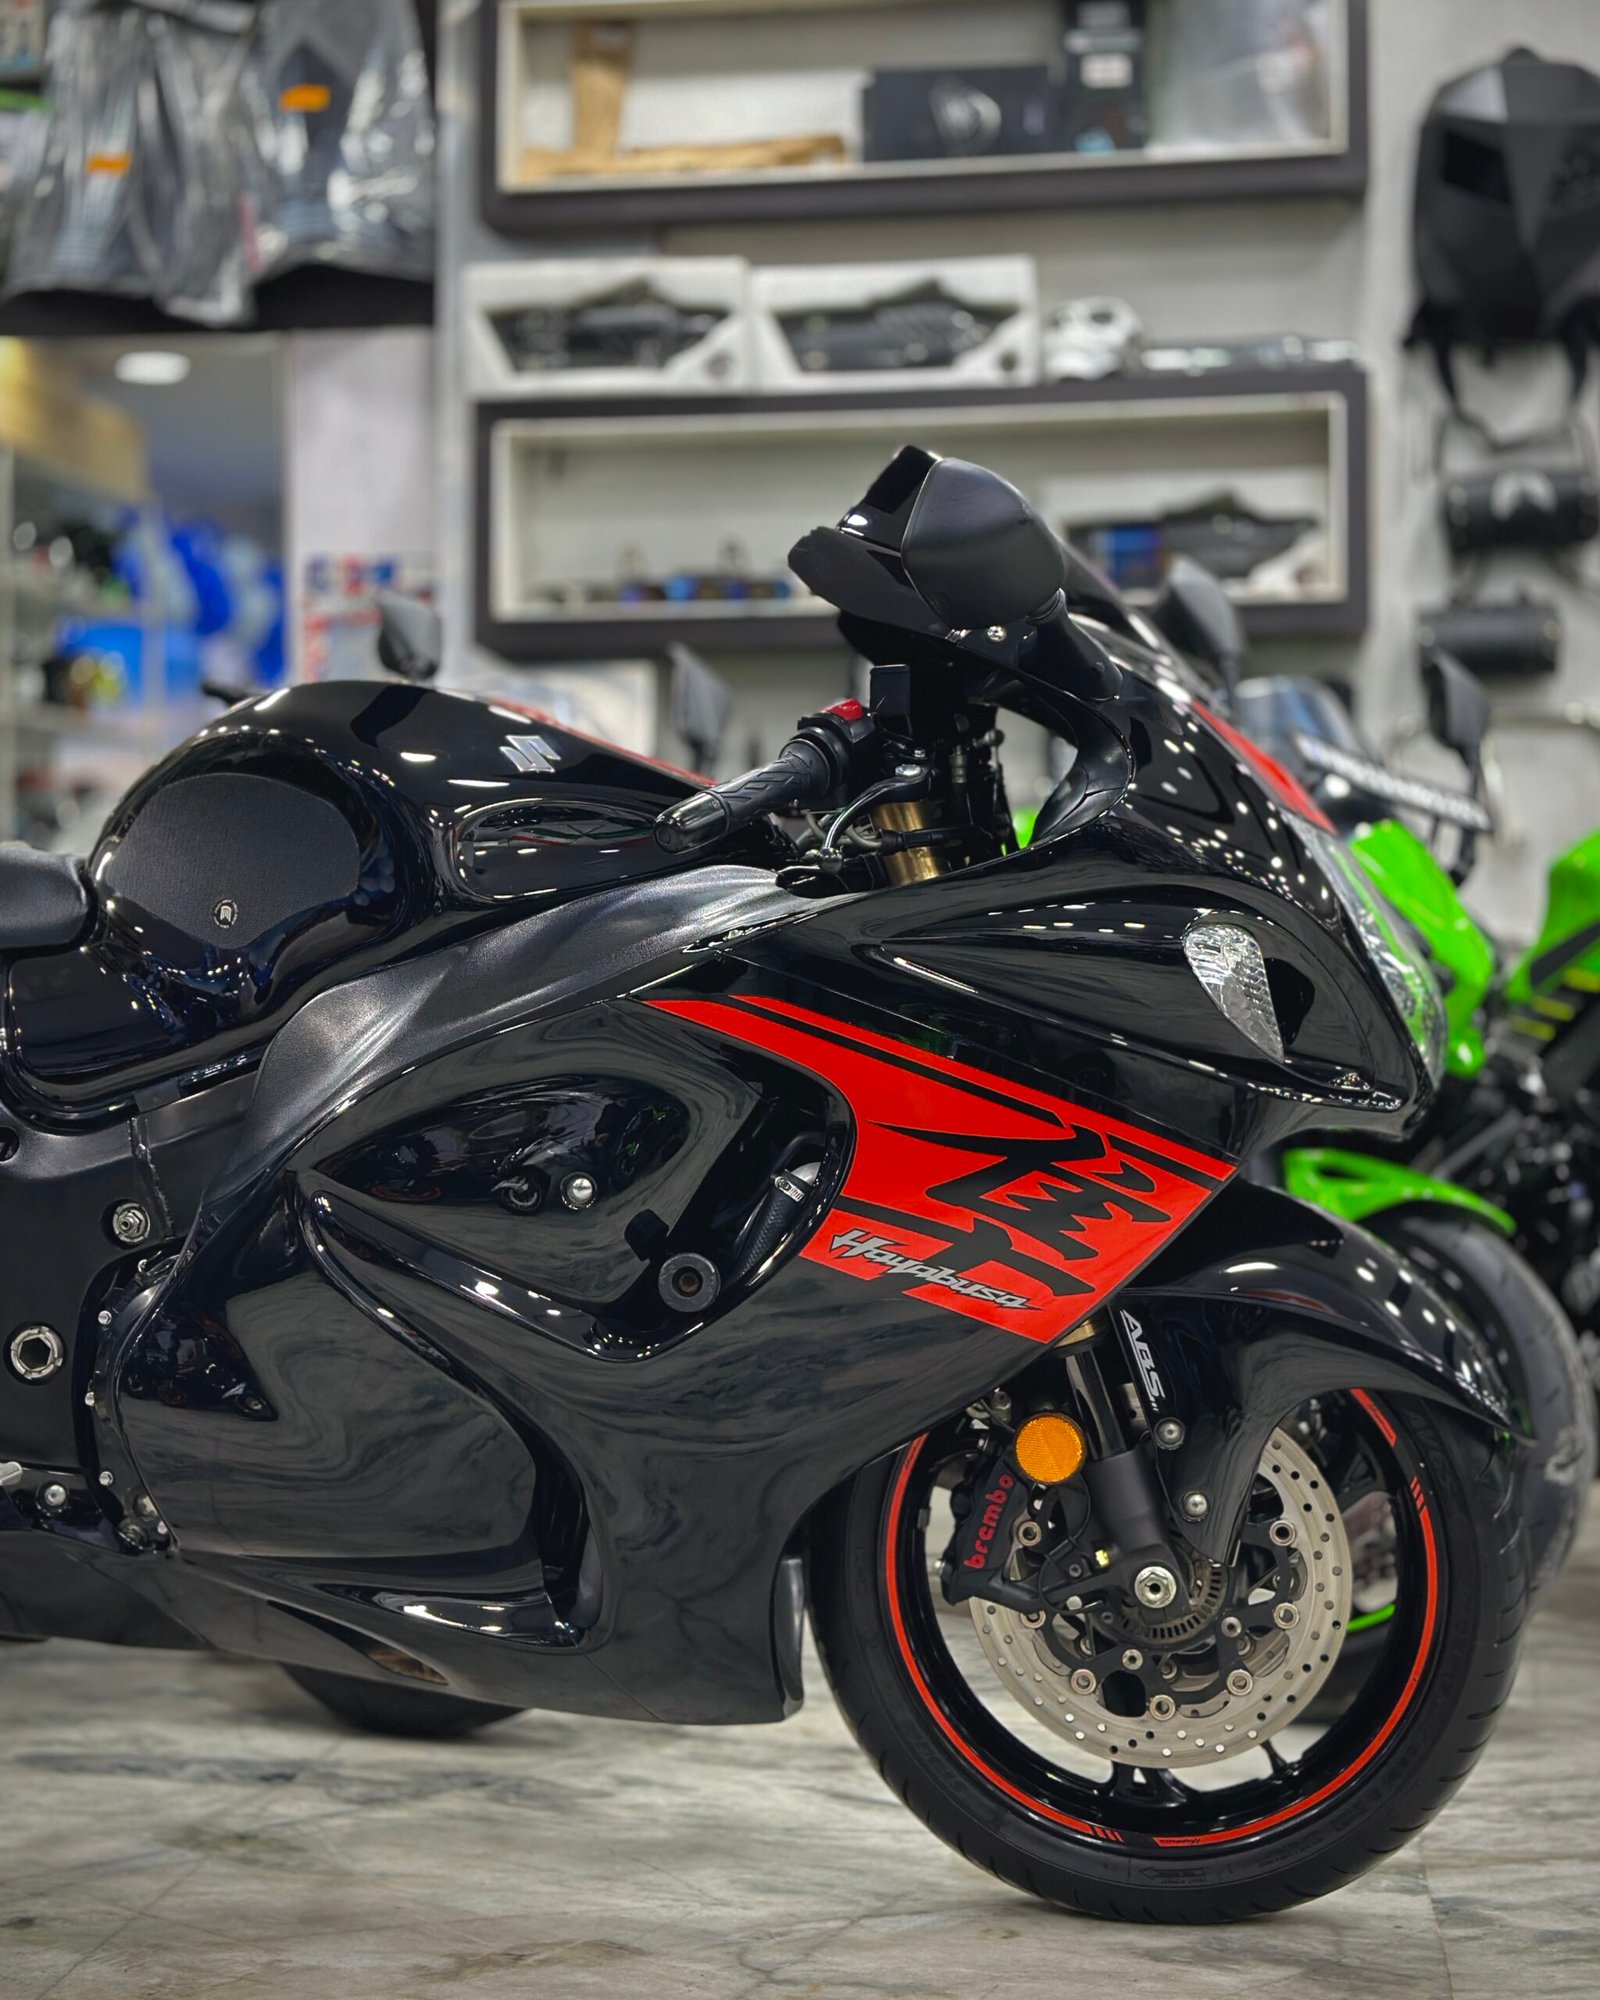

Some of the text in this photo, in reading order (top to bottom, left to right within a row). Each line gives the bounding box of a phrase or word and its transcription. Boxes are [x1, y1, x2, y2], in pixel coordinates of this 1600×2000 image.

[828, 1227, 1045, 1311] Hayabusa
[1119, 1308, 1167, 1402] ABS
[964, 1473, 1014, 1570] brembo
